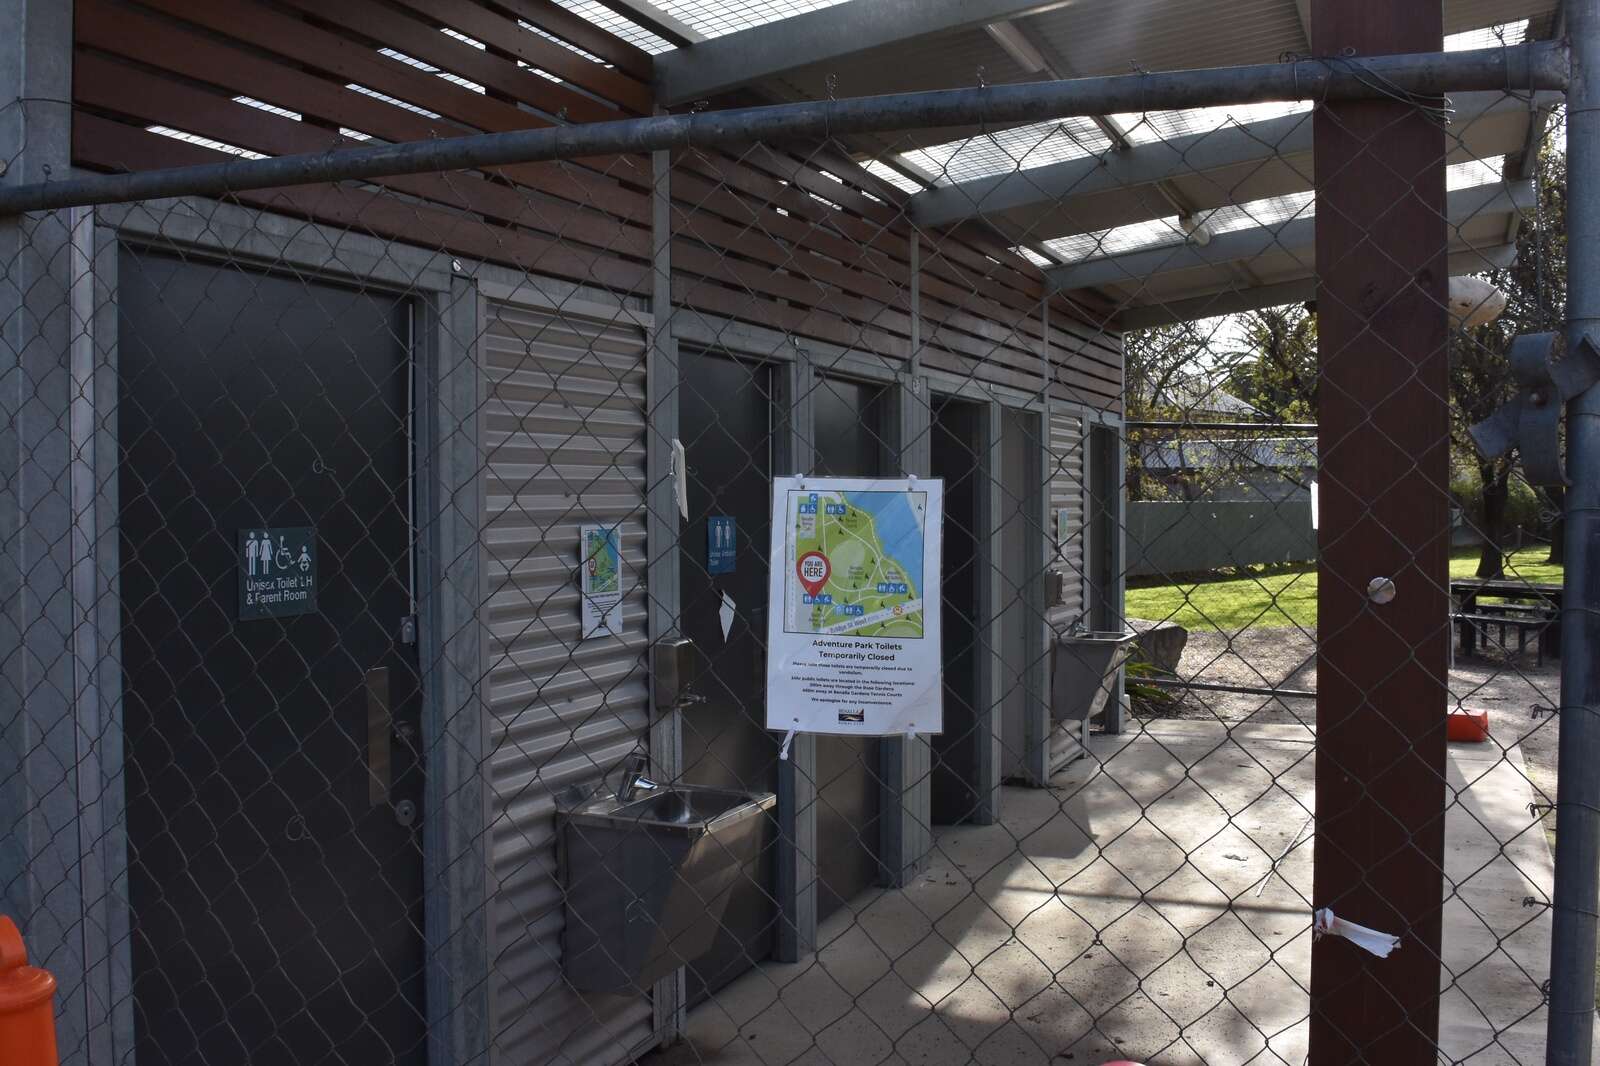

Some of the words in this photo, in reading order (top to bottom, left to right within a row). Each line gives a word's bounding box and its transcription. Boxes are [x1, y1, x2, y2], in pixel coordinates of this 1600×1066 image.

[804, 567, 824, 577] HERE
[246, 578, 275, 591] Unisex
[276, 576, 298, 589] Toilet
[246, 592, 254, 605] &
[255, 591, 282, 604] Parent
[283, 589, 307, 601] Room
[812, 639, 853, 648] Adventure
[854, 641, 873, 649] Park
[875, 642, 903, 650] Toilets
[819, 650, 866, 661] Temporarily
[867, 652, 895, 661] Closed
